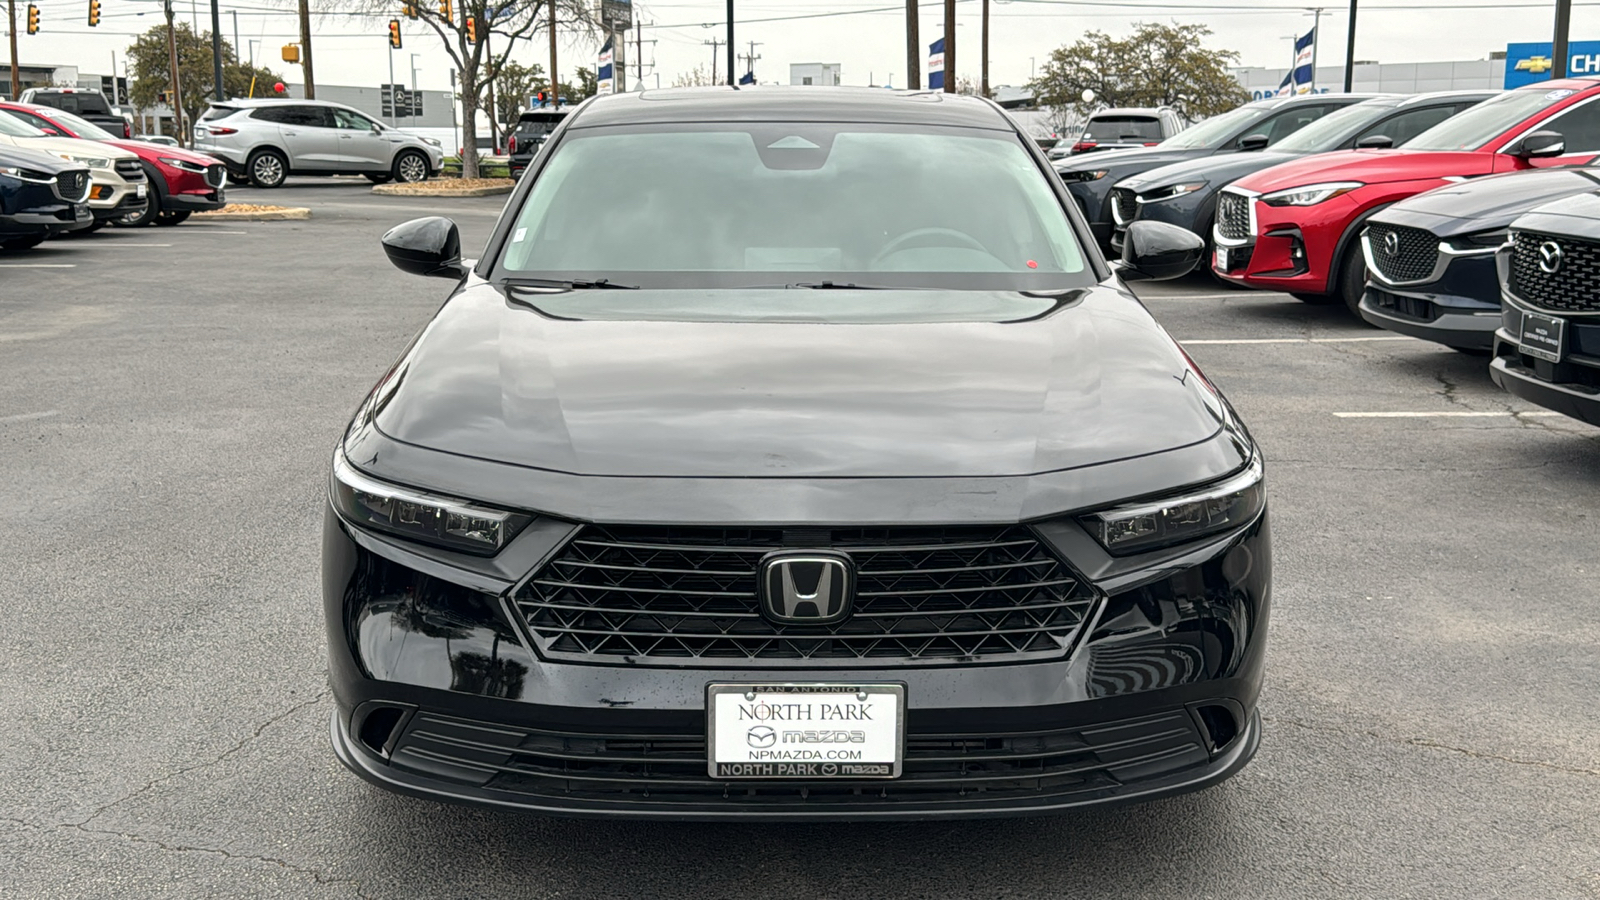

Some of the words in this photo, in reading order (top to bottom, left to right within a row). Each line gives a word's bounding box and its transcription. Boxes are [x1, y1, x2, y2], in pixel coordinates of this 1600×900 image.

[738, 702, 812, 721] NORTH
[820, 703, 874, 721] PARK
[782, 730, 866, 744] mazda
[749, 750, 862, 760] NPMAZDA.COM
[720, 763, 773, 776] NORTH
[778, 763, 818, 776] PARK
[841, 764, 890, 775] mazda
